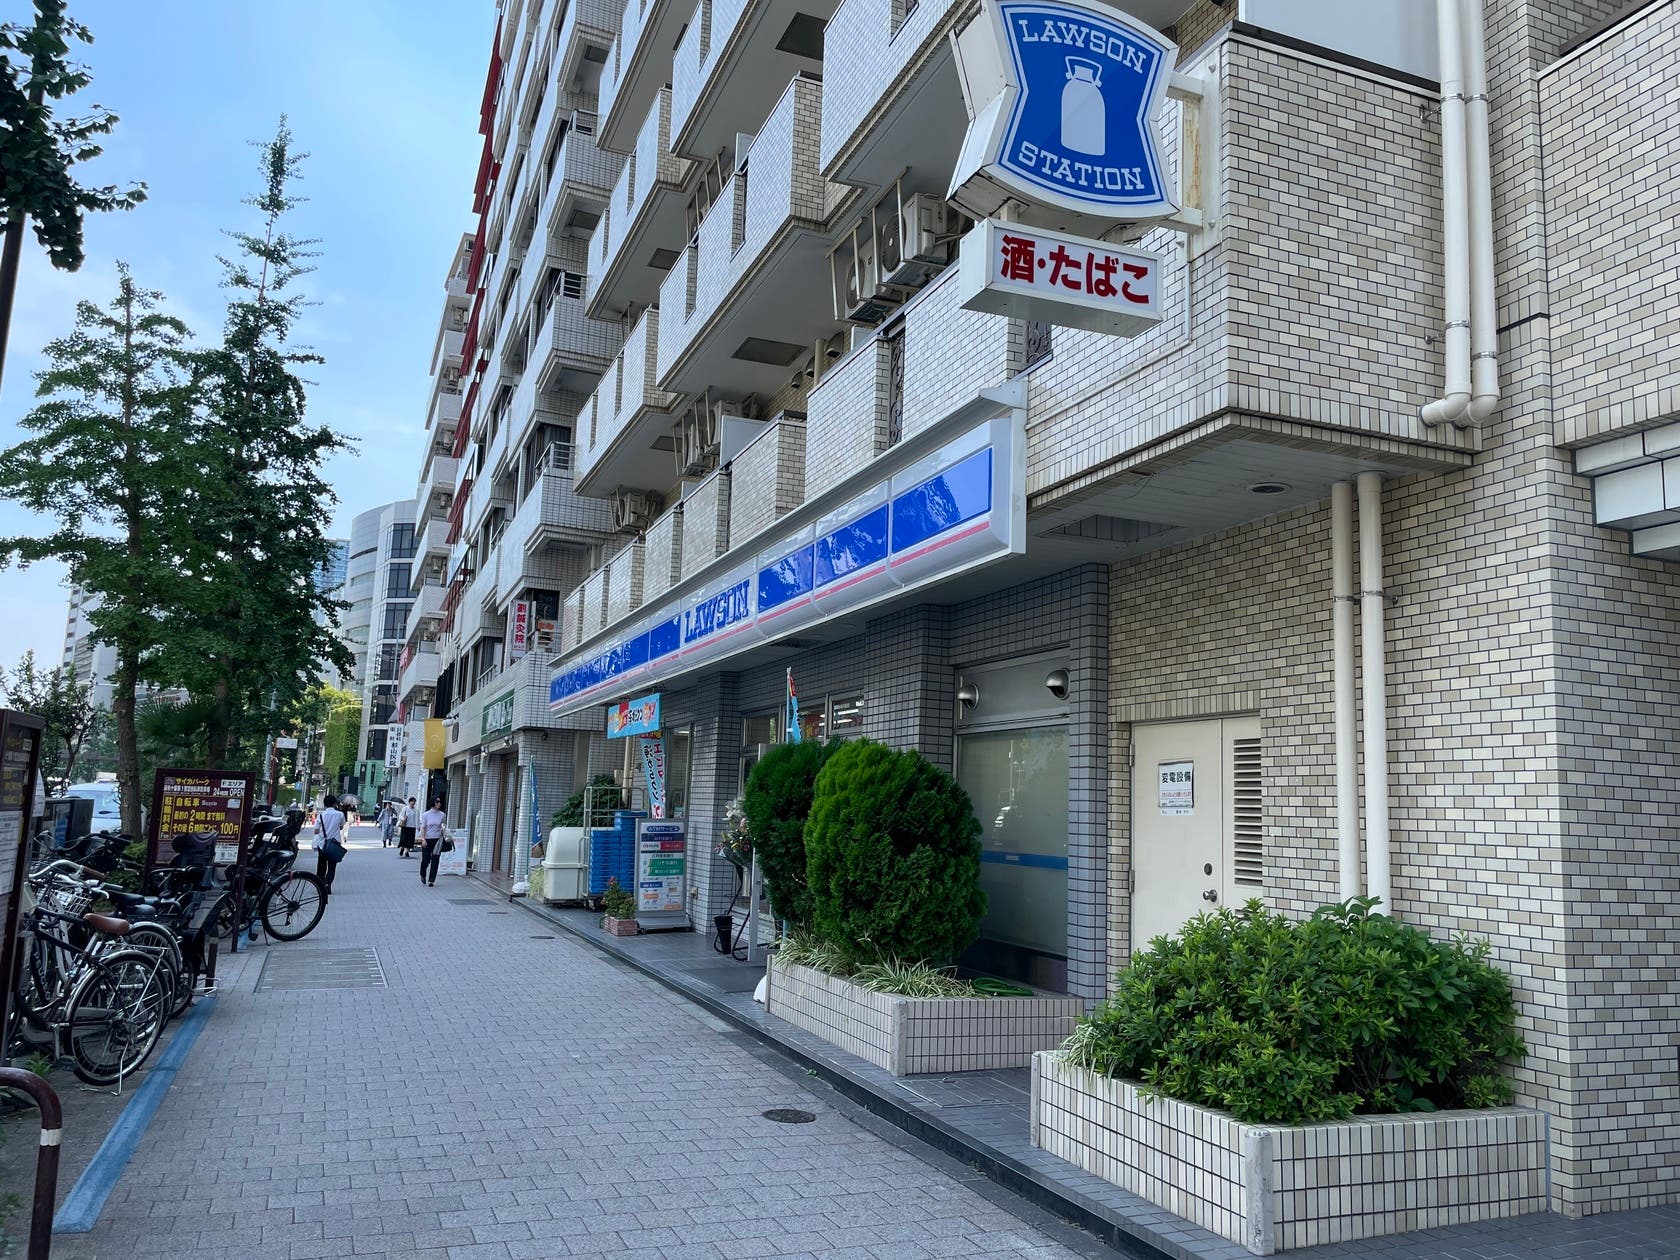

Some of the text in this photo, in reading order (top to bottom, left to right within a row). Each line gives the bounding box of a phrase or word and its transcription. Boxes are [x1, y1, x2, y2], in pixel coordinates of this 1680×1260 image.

[1018, 19, 1147, 74] LAWSON
[1018, 141, 1145, 190] STATION
[684, 579, 750, 643] LAWSON
[229, 788, 244, 797] OPEN
